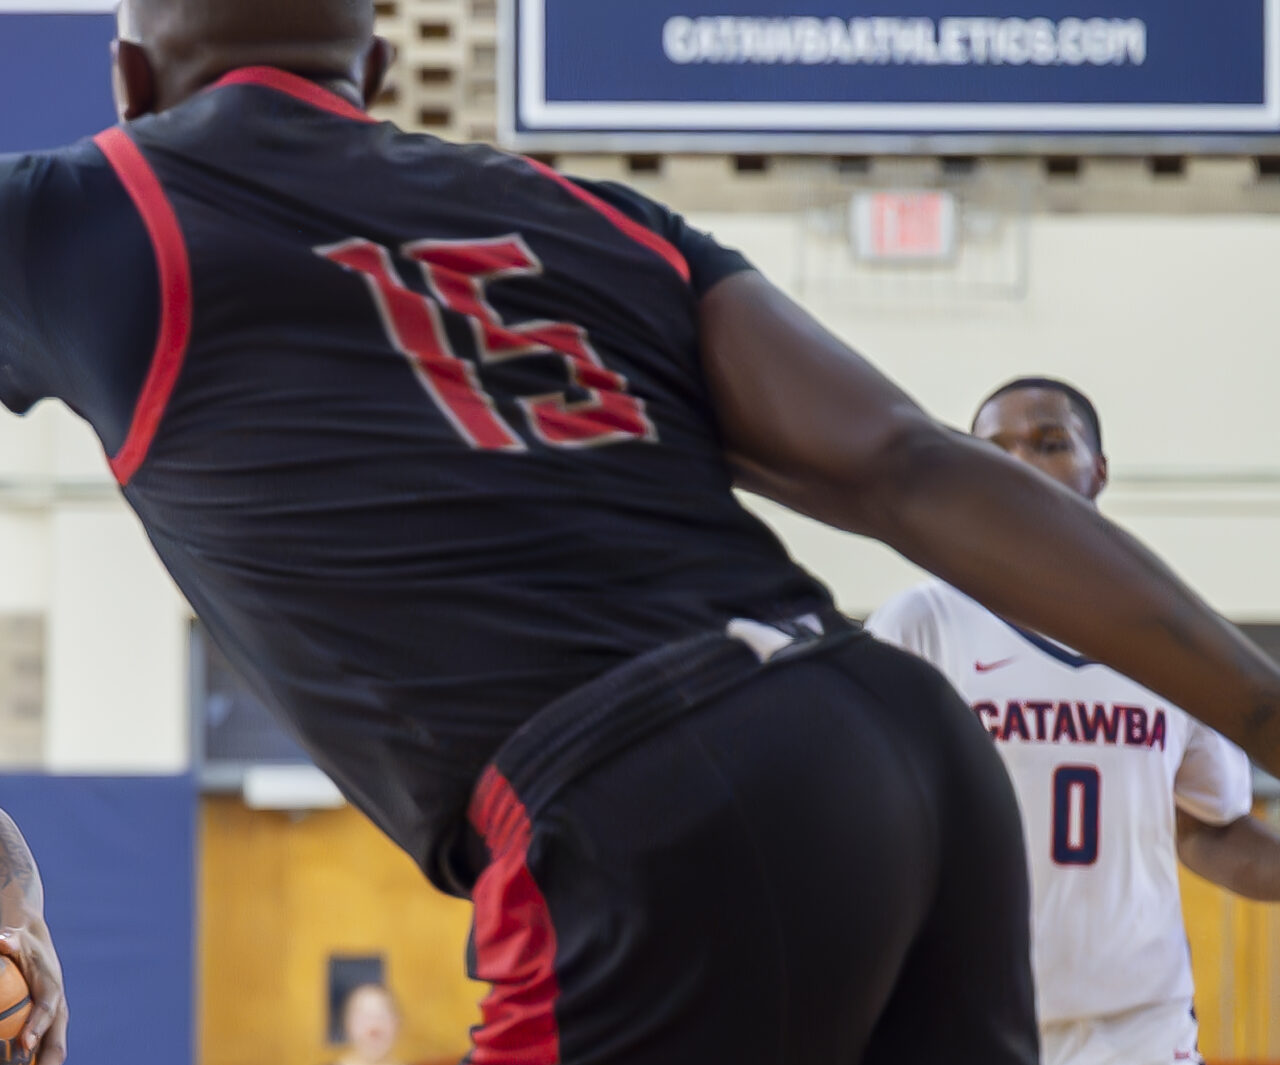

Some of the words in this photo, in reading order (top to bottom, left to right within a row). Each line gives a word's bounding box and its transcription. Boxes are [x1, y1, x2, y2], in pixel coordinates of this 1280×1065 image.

[663, 14, 1146, 65] CATAWBAATHLETICS.COM
[312, 233, 660, 452] 15
[972, 701, 1167, 752] CATAWBA
[1051, 763, 1101, 867] 0
